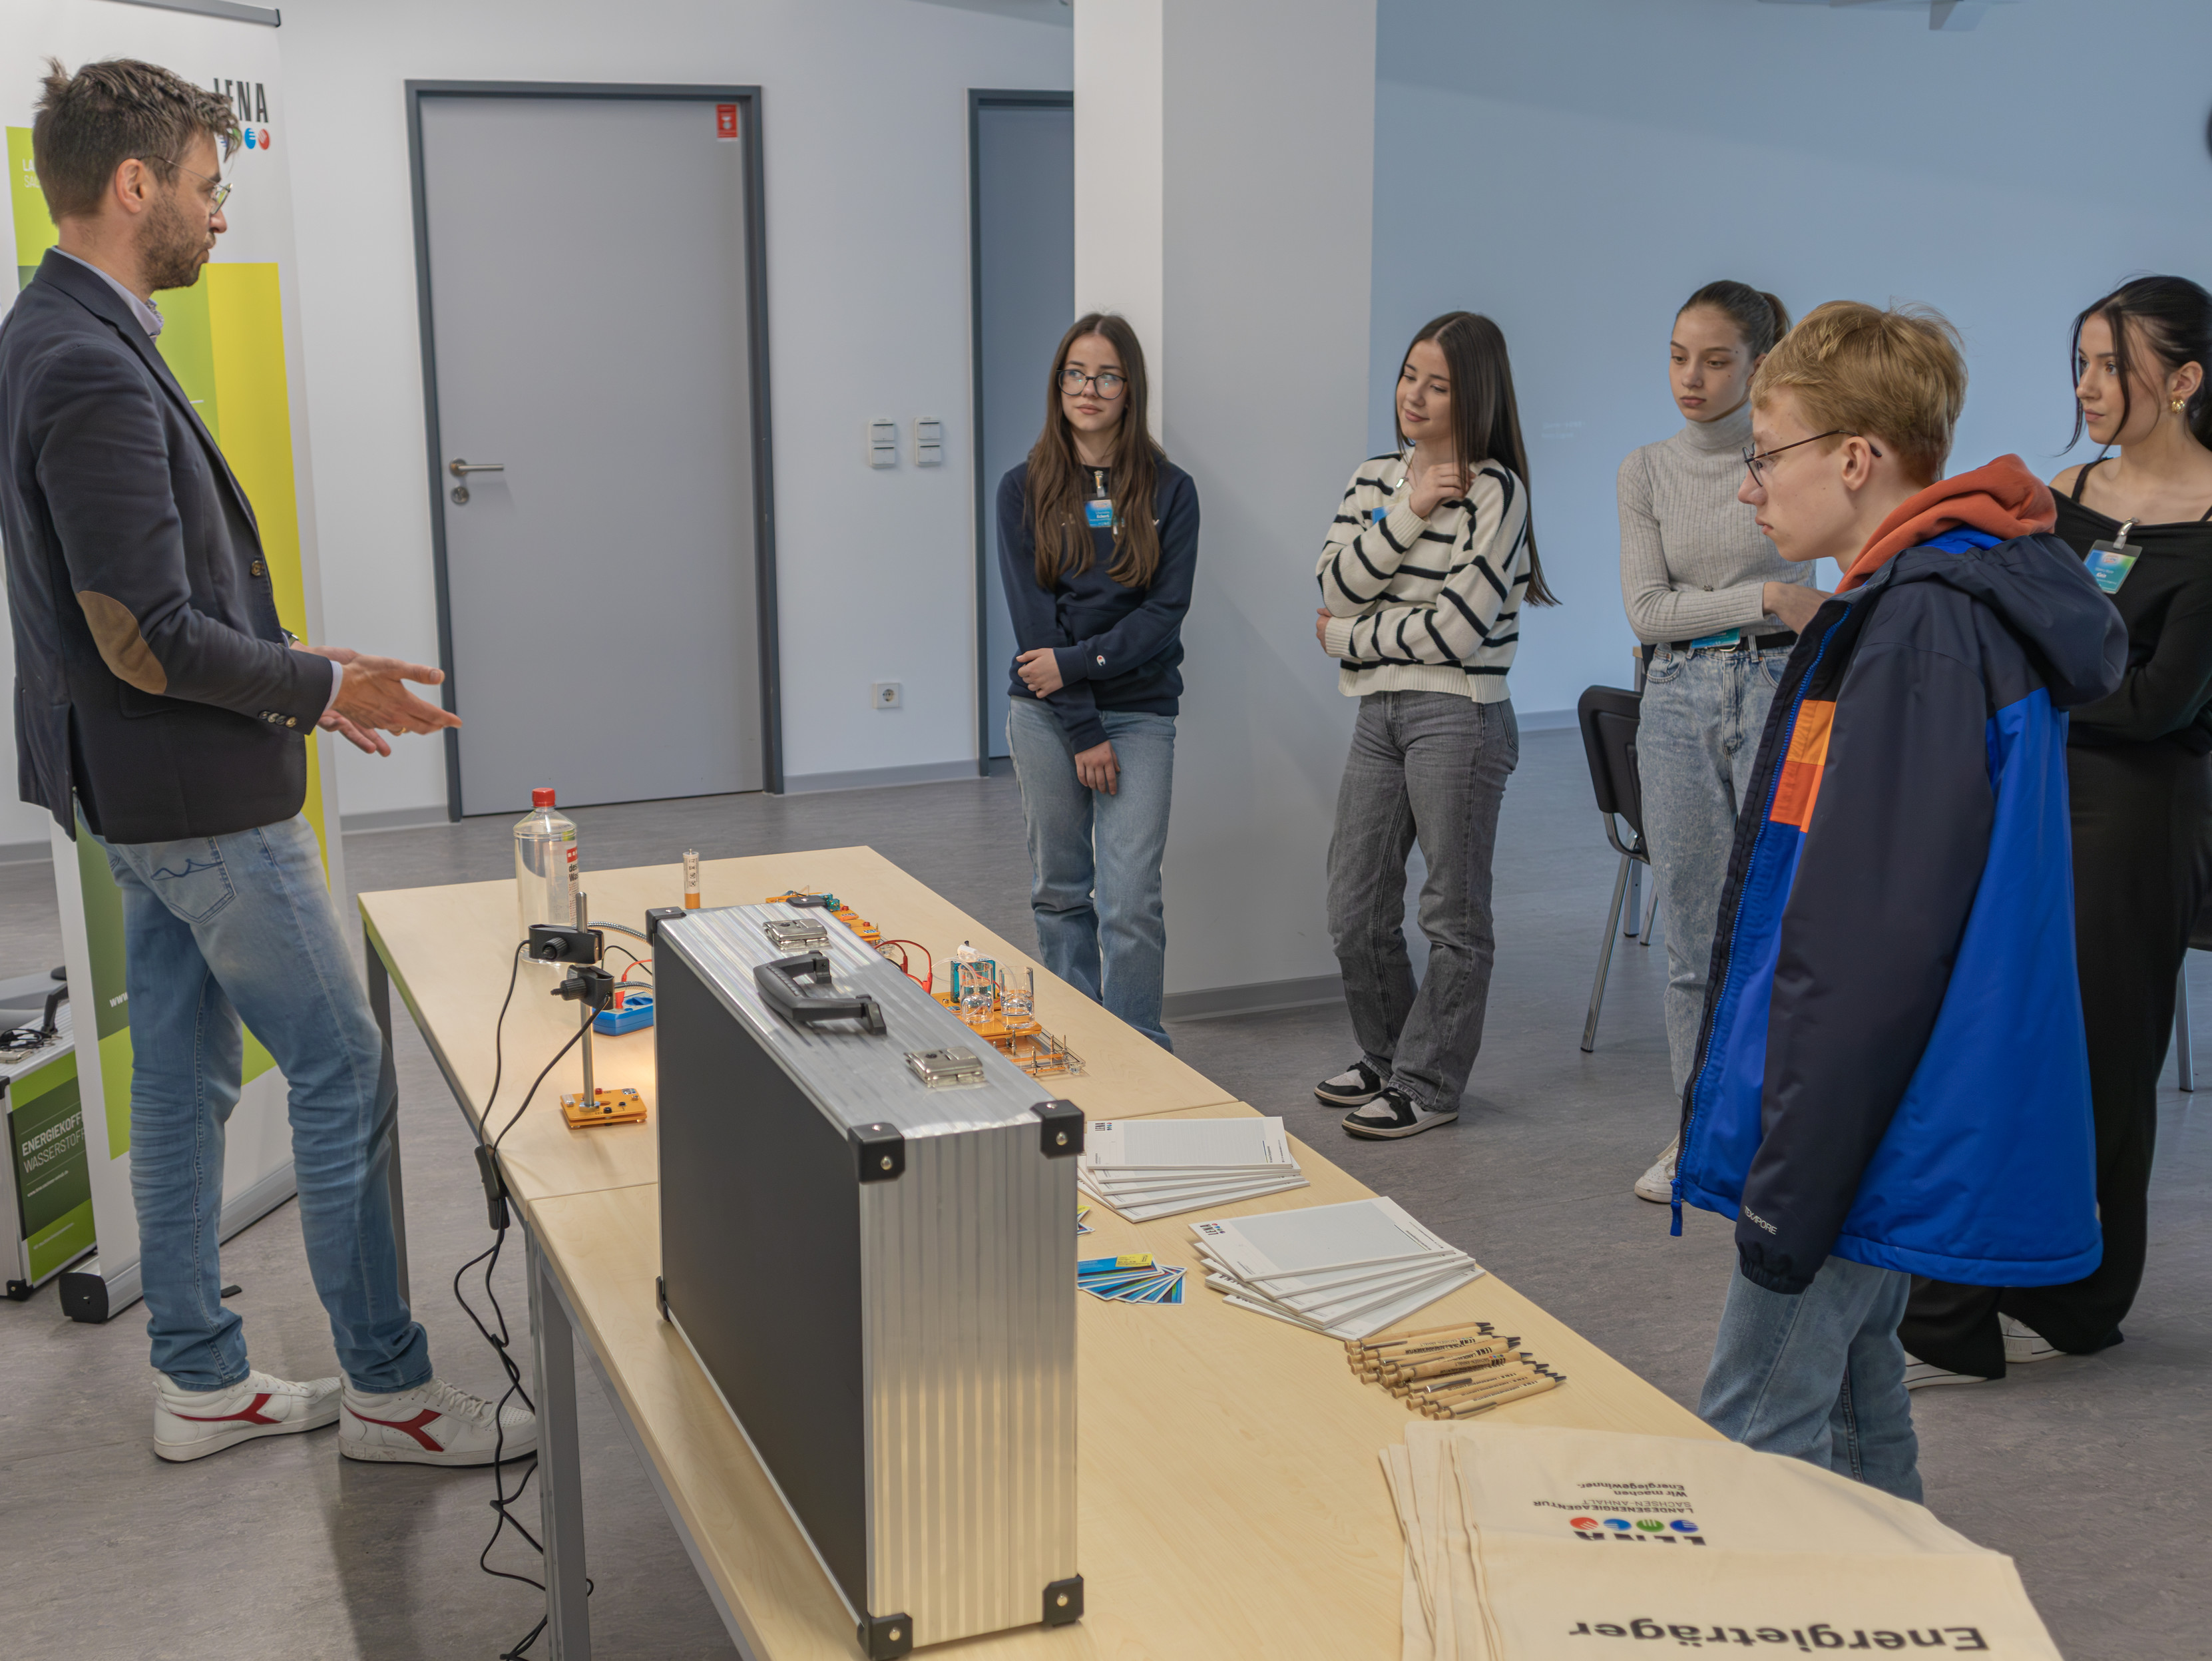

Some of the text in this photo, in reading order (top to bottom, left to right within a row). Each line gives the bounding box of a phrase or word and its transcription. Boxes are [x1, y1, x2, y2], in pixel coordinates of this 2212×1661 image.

[1095, 1122, 1105, 1131] LENA
[1745, 1205, 1777, 1235] TEXAPORE
[1200, 1224, 1219, 1236] LENA
[1533, 1501, 1694, 1514] LANDESENERGIEAGENTUR
[1582, 1499, 1692, 1508] SACHSEN-ANHALT
[1569, 1618, 1990, 1653] Energieträger
